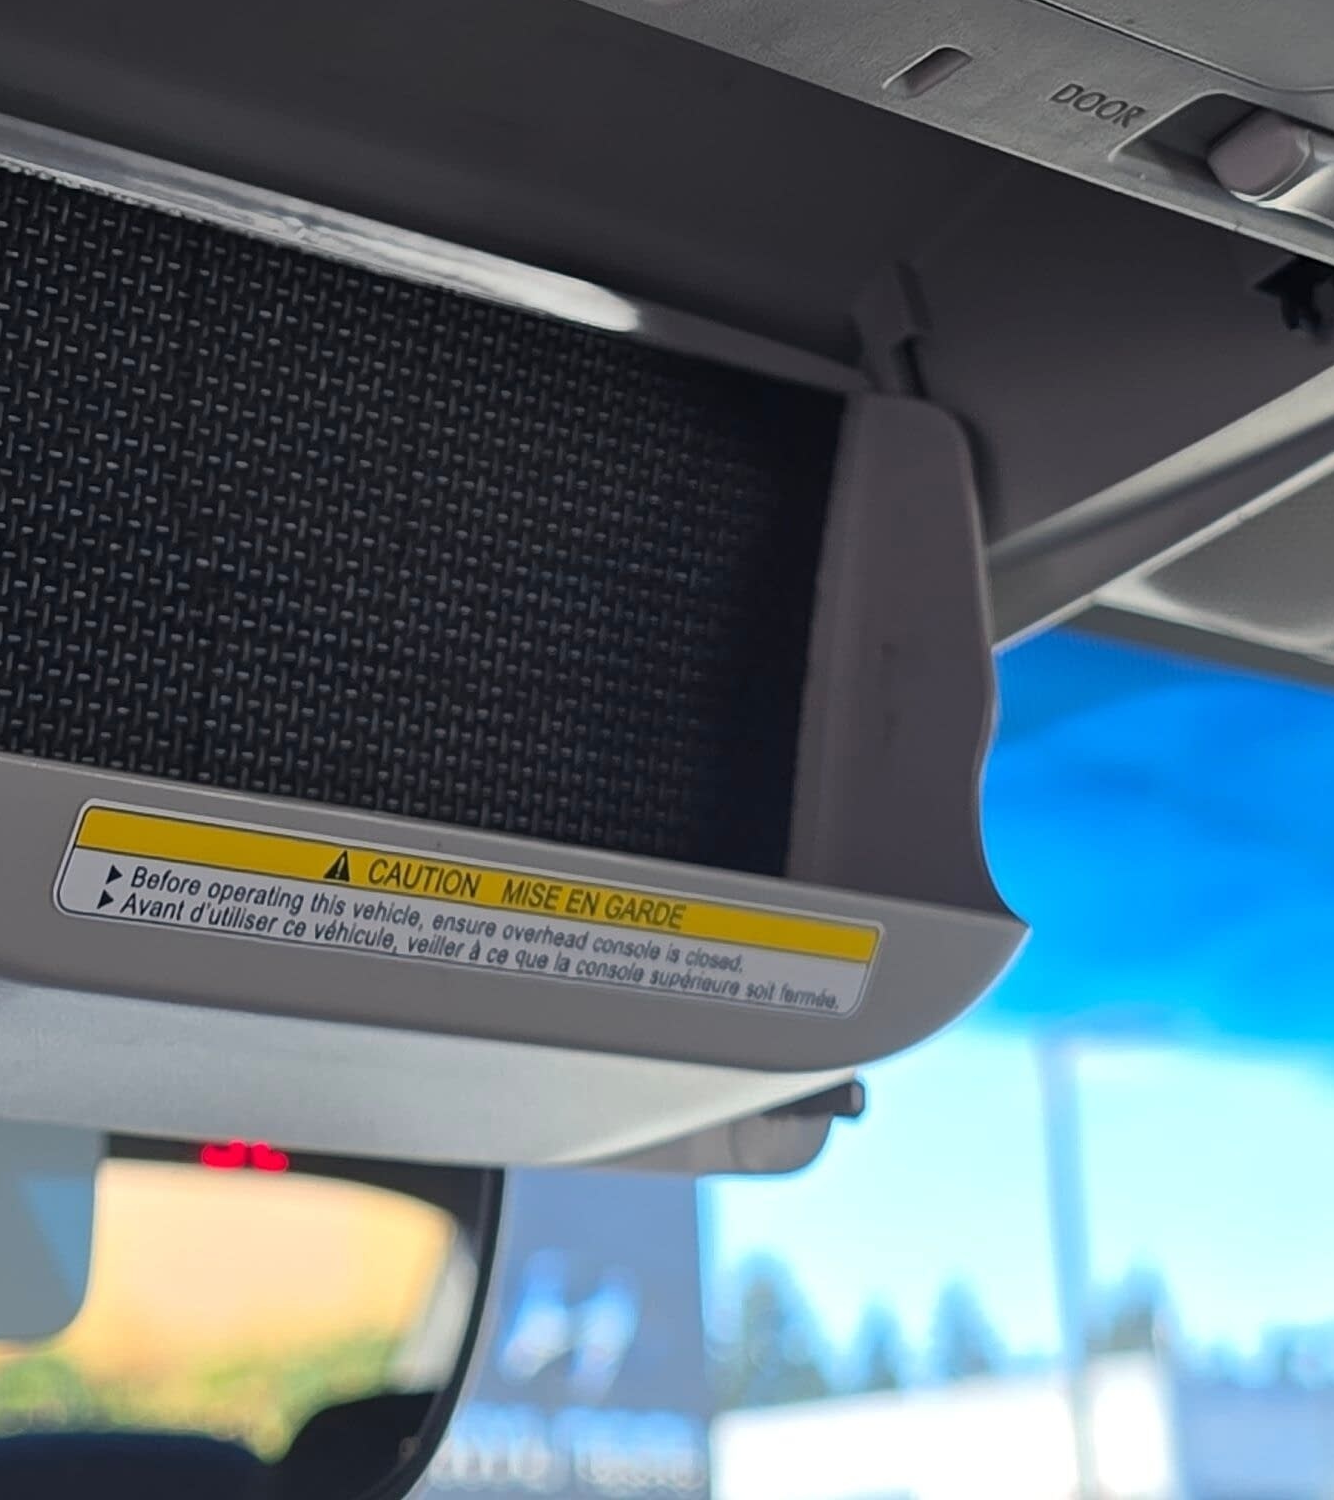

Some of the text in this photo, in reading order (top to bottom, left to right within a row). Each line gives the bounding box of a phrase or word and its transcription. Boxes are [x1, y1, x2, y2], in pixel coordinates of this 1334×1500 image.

[1049, 82, 1146, 129] DOOR
[130, 865, 201, 896] Before
[207, 881, 304, 916] operating
[310, 893, 347, 915] this
[353, 899, 424, 931] vehicle,
[432, 913, 497, 938] ensure
[502, 923, 590, 951] overhead
[592, 936, 661, 961] console
[664, 943, 680, 964] is
[367, 858, 687, 930] CAUTION MISE EN GARDE
[120, 892, 840, 1011] Avant d'utiliser ce véhicule, veiller à ce que la console supérieure soit fermée.
